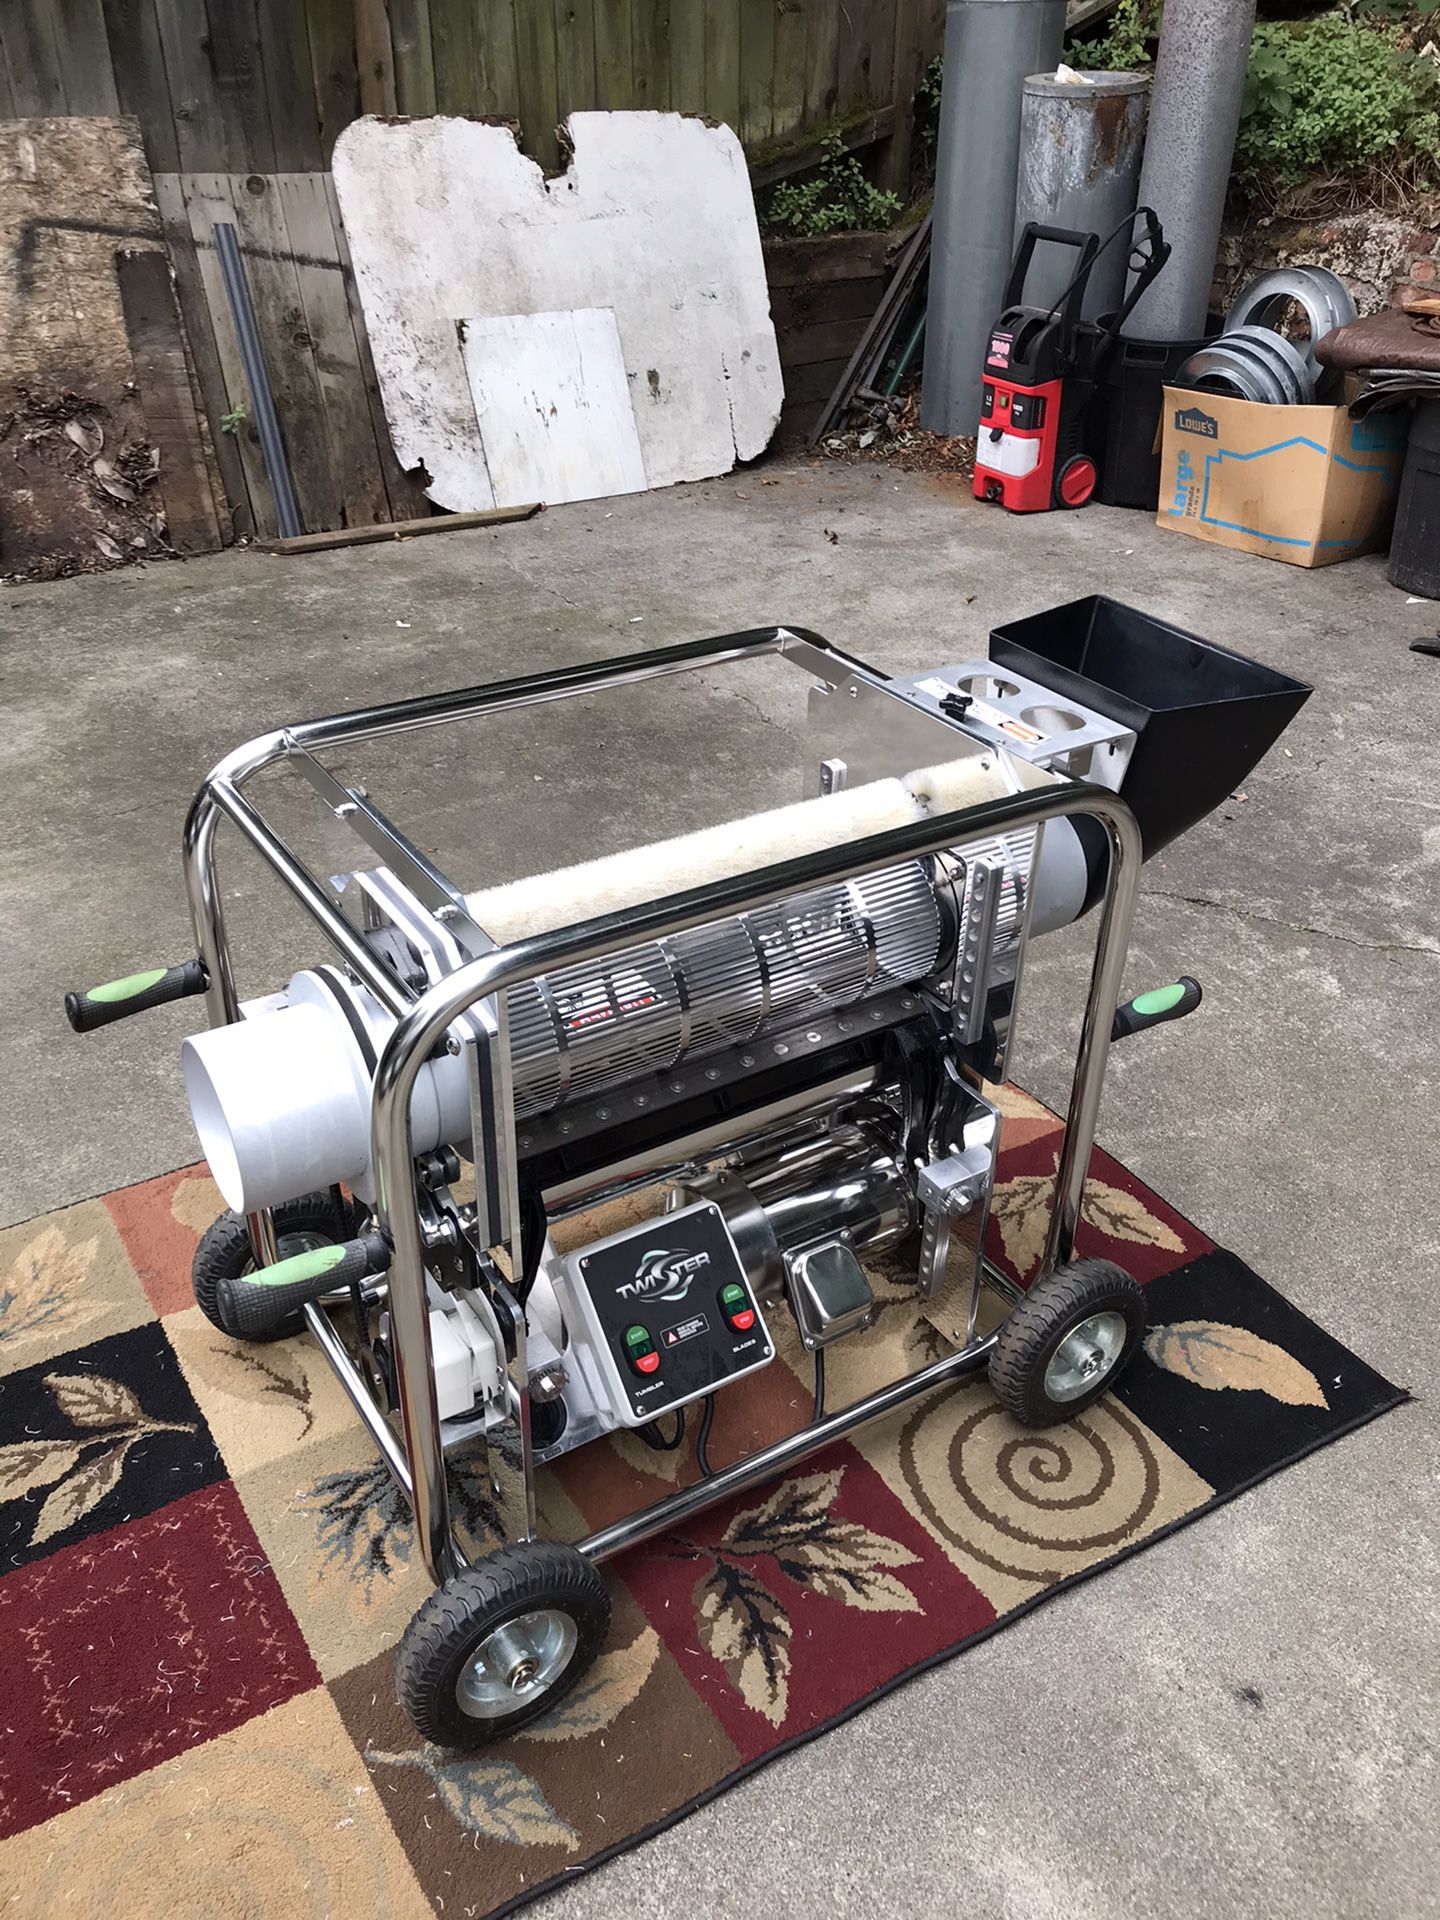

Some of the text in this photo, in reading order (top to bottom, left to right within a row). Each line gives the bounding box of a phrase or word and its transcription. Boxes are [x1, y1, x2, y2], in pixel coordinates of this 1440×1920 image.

[1179, 414, 1214, 435] LOWE'S
[1185, 486, 1195, 517] grande
[615, 1251, 711, 1299] TWISTER
[732, 1338, 757, 1353] BLADES
[634, 1380, 665, 1398] TUMBLER
